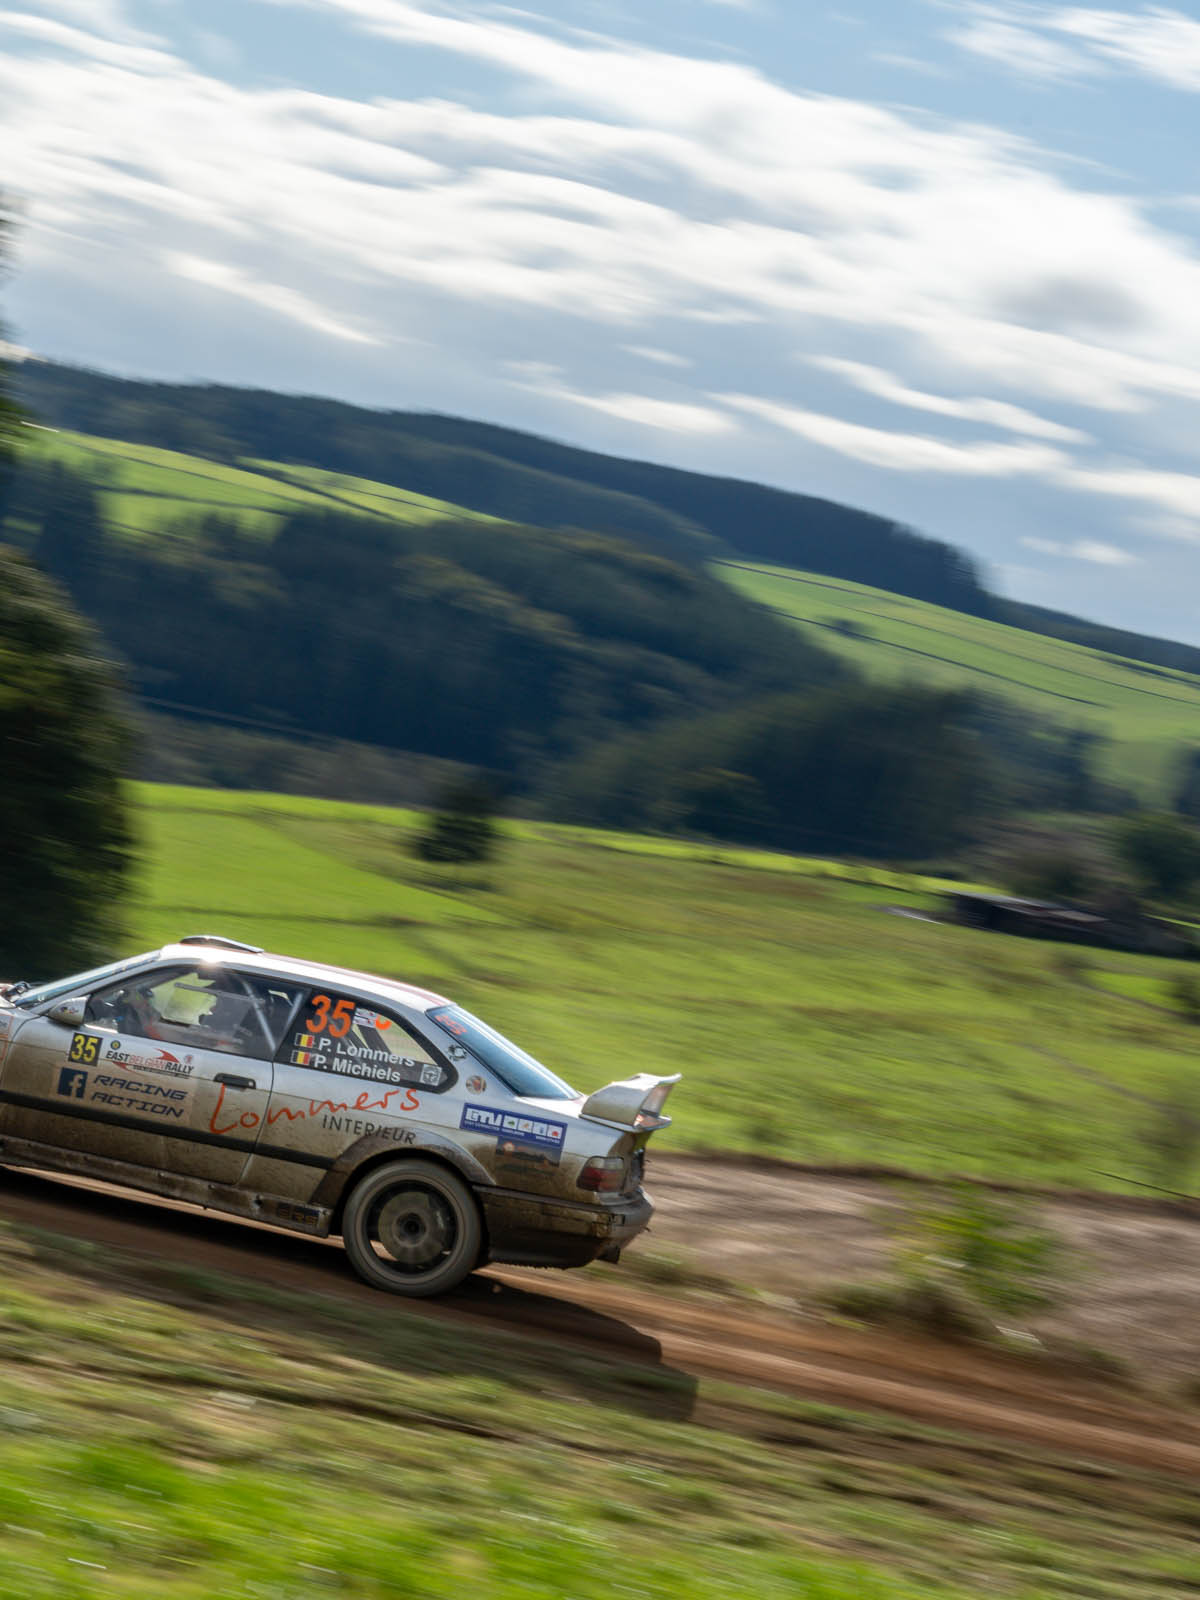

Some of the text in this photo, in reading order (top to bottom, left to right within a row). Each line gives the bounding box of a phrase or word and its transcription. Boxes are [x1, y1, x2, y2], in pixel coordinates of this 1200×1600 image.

[305, 994, 356, 1038] 35
[71, 1034, 98, 1062] 35
[318, 1037, 416, 1067] P. Lommers
[314, 1053, 402, 1083] P. Michiels
[93, 1074, 189, 1101] RACING
[91, 1091, 185, 1118] ACTION
[210, 1082, 421, 1135] Lommers
[322, 1114, 417, 1145] INTERIEUR
